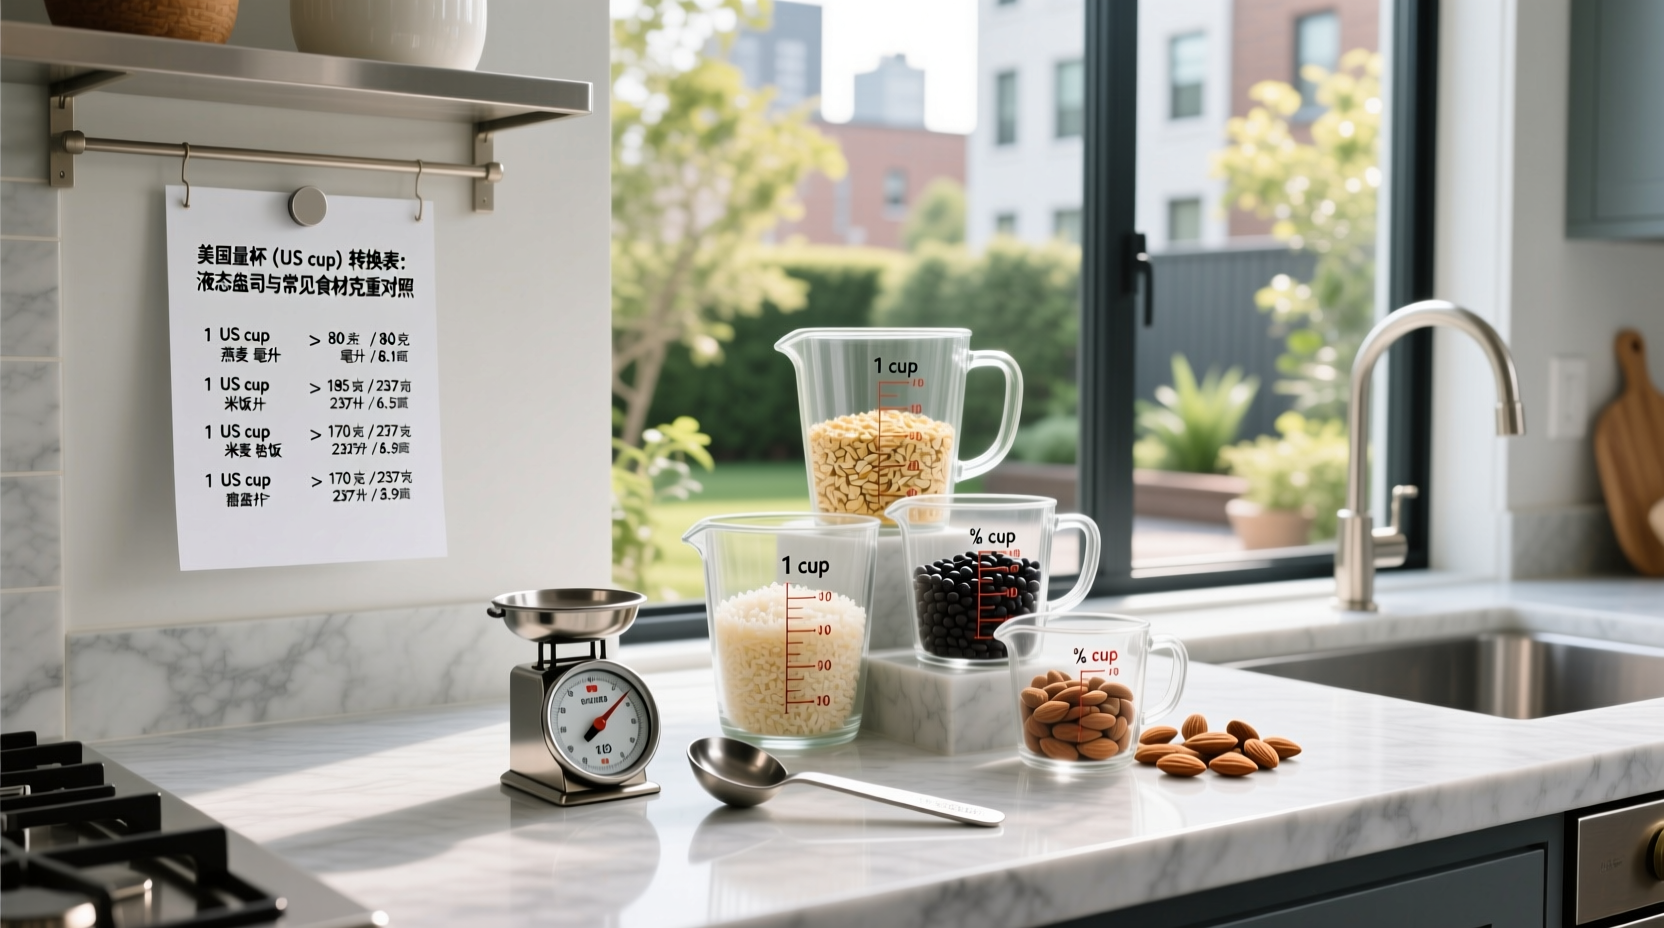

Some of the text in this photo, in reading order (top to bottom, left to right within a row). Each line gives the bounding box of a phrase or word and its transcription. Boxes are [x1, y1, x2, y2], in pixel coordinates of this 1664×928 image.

[198, 244, 267, 266] 美国量杯
[273, 247, 303, 268] (US
[308, 249, 342, 271] cup)
[204, 327, 270, 346] 1 US cup
[874, 357, 918, 378] 1 cup
[204, 376, 269, 395] 1 US cup
[205, 424, 270, 442] 1 US cup
[206, 472, 271, 490] 1 US cup
[988, 532, 1016, 548] cup
[782, 556, 829, 578] 1 cup
[1092, 650, 1118, 665] cup
